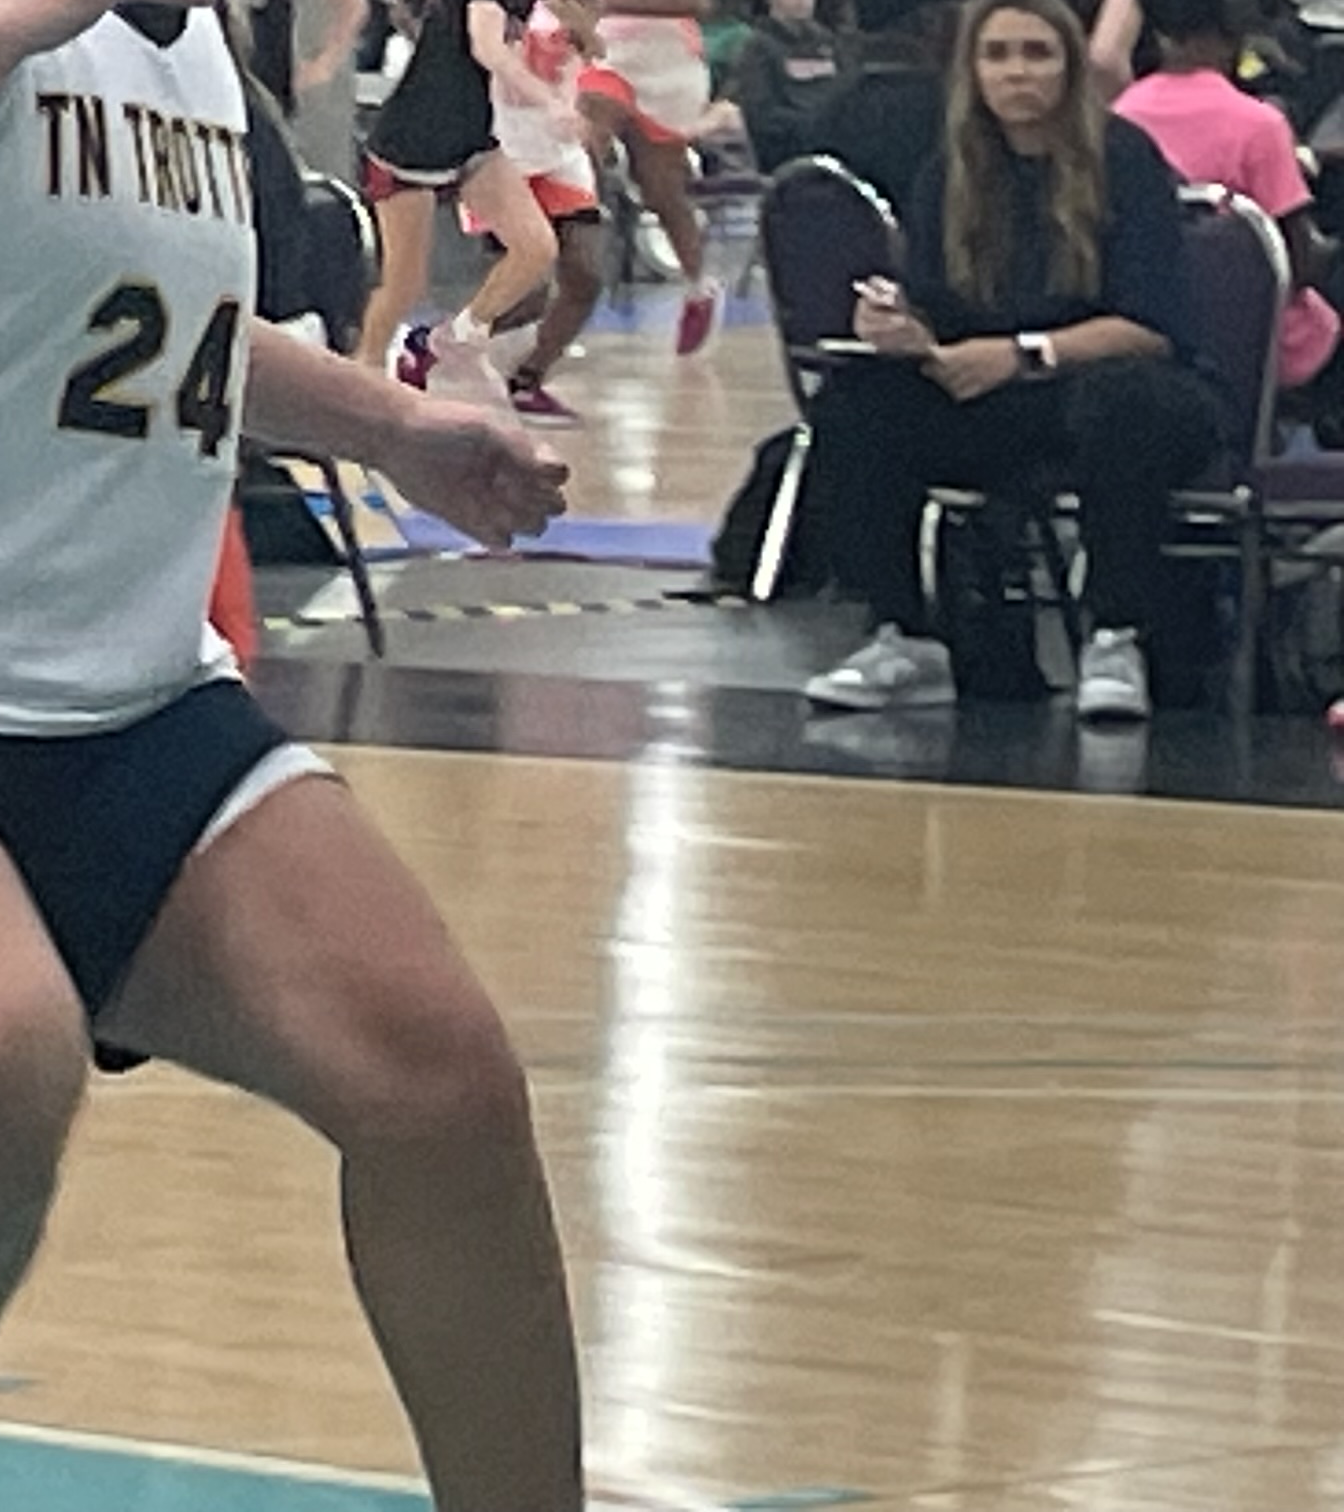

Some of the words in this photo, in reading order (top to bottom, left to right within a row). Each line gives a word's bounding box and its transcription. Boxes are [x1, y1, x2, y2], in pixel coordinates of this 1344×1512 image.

[36, 92, 112, 200] TN
[123, 102, 253, 226] TROTT
[55, 273, 243, 460] 24
